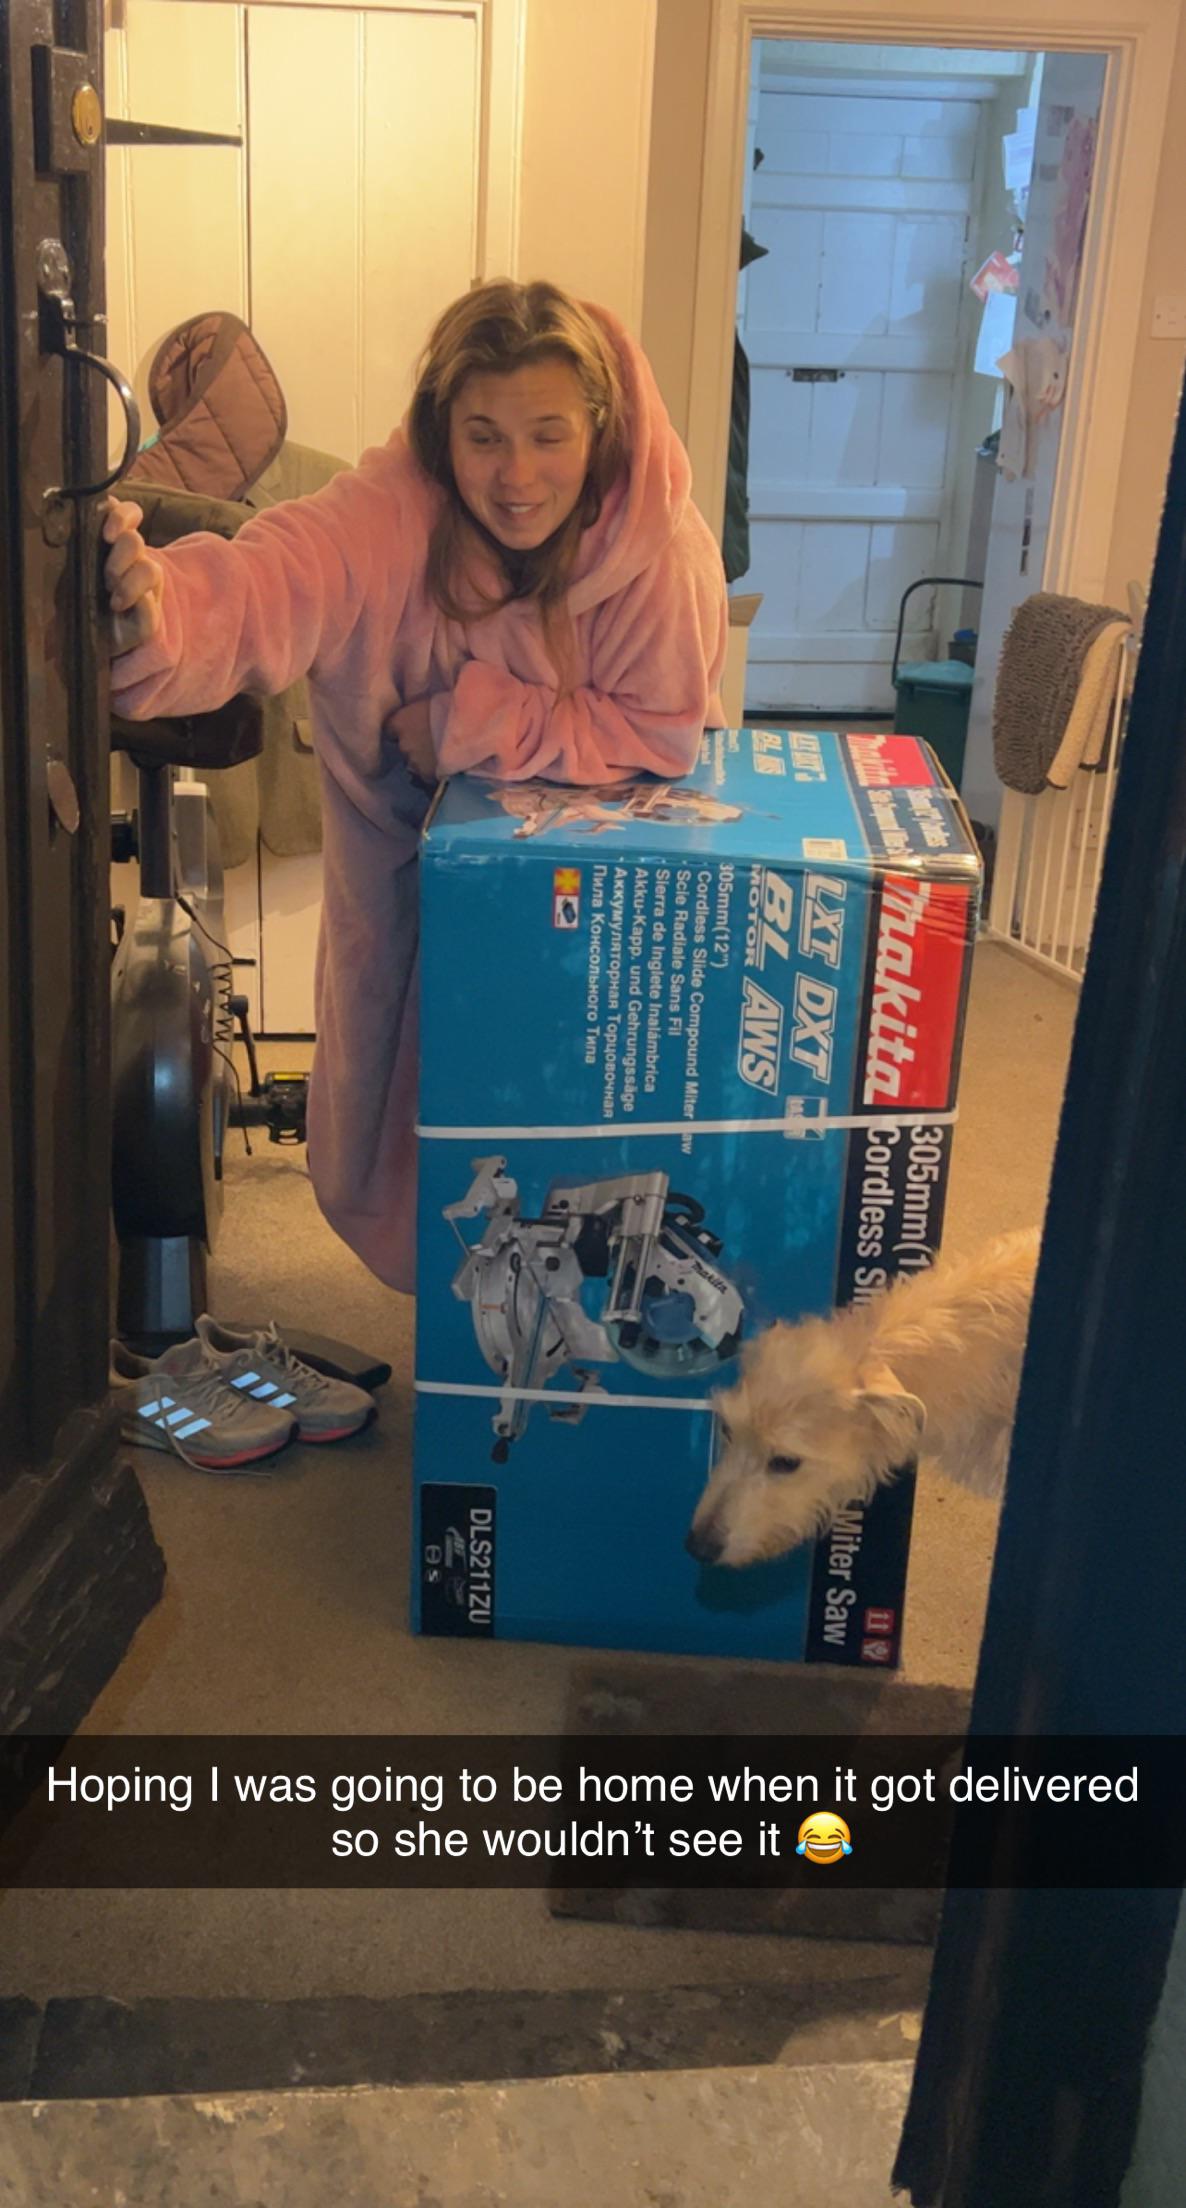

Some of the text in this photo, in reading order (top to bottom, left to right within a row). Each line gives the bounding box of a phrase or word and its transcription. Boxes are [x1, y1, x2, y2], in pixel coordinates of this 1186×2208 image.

[584, 864, 608, 1064] Пила Консольного Типа
[667, 869, 692, 1036] Scie Radiale Sans Fil
[691, 948, 707, 988] Slide
[694, 871, 712, 943] Cordless
[744, 863, 761, 967] MOTOR
[799, 869, 847, 970] LXT
[603, 866, 628, 1118] Аккумуляторная Торцовочная
[620, 867, 649, 1112] Akku-Kapp. und Gehrungssäge
[644, 868, 671, 1093] Sierra de Inglete Inalámbrica
[684, 992, 704, 1077] Compound
[739, 868, 794, 1093] BL AWS
[790, 972, 838, 1084] DXT
[683, 1081, 699, 1119] Miter
[856, 1125, 901, 1258] Cordless
[468, 1508, 492, 1624] DLS211ZU
[822, 1510, 864, 1646] Miter Saw
